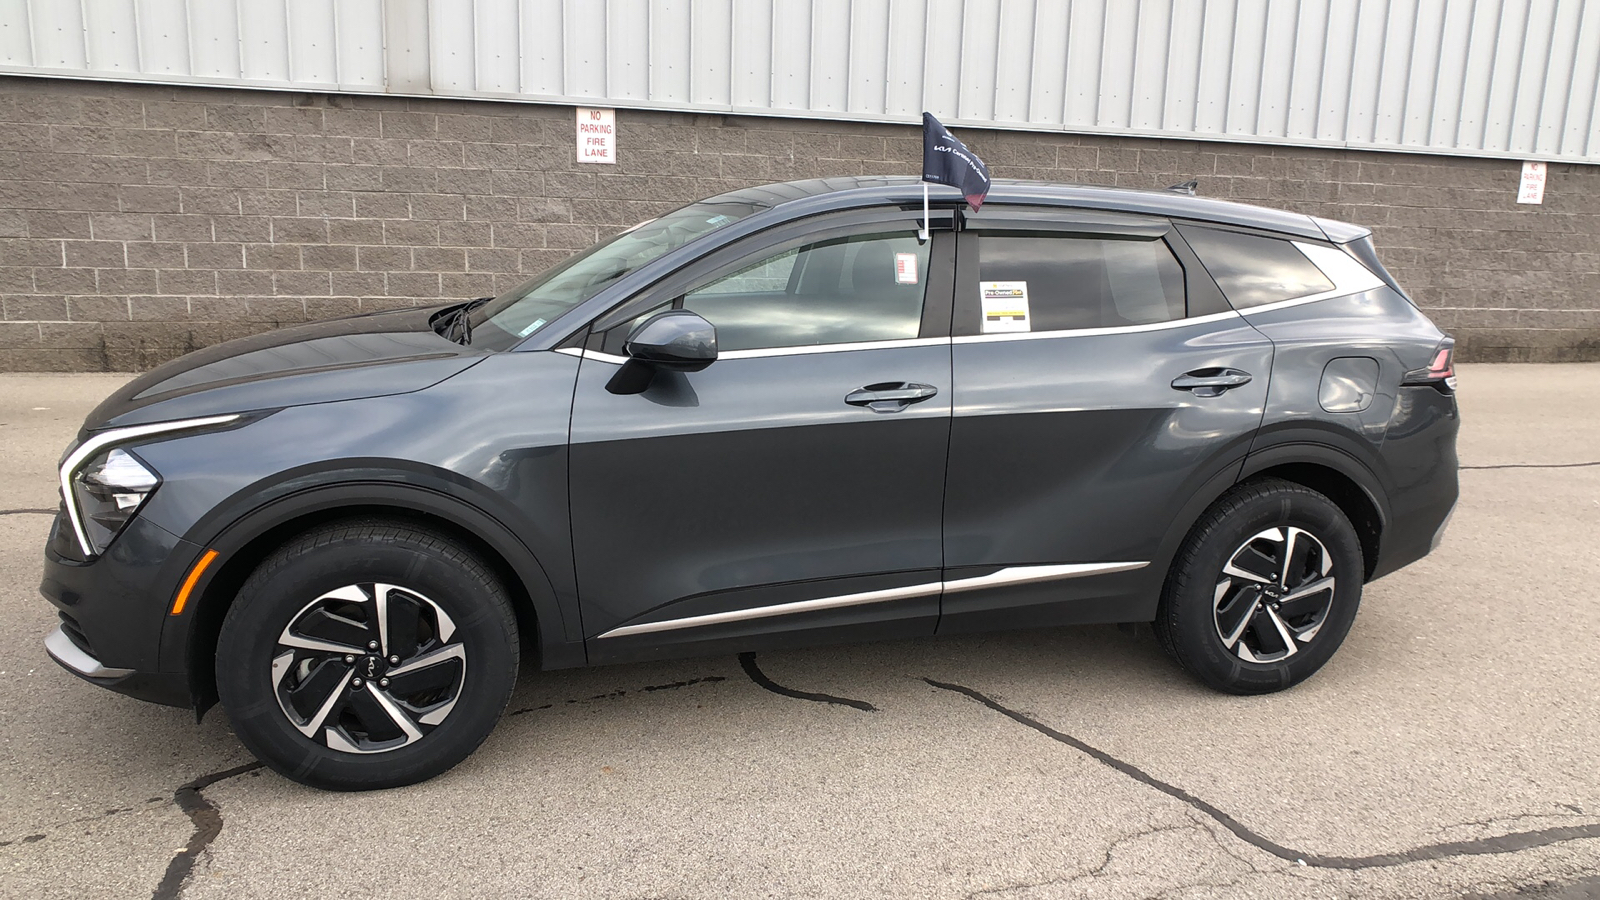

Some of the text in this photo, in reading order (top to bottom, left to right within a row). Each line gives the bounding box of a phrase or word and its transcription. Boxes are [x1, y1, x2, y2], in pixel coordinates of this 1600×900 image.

[590, 111, 601, 121] NO
[580, 123, 612, 135] PARKING
[587, 138, 606, 147] FIRE
[585, 148, 608, 158] LANE
[934, 145, 952, 153] KIA
[1530, 162, 1538, 171] NO
[1523, 172, 1543, 181] PARKING
[1526, 183, 1538, 191] FIRE
